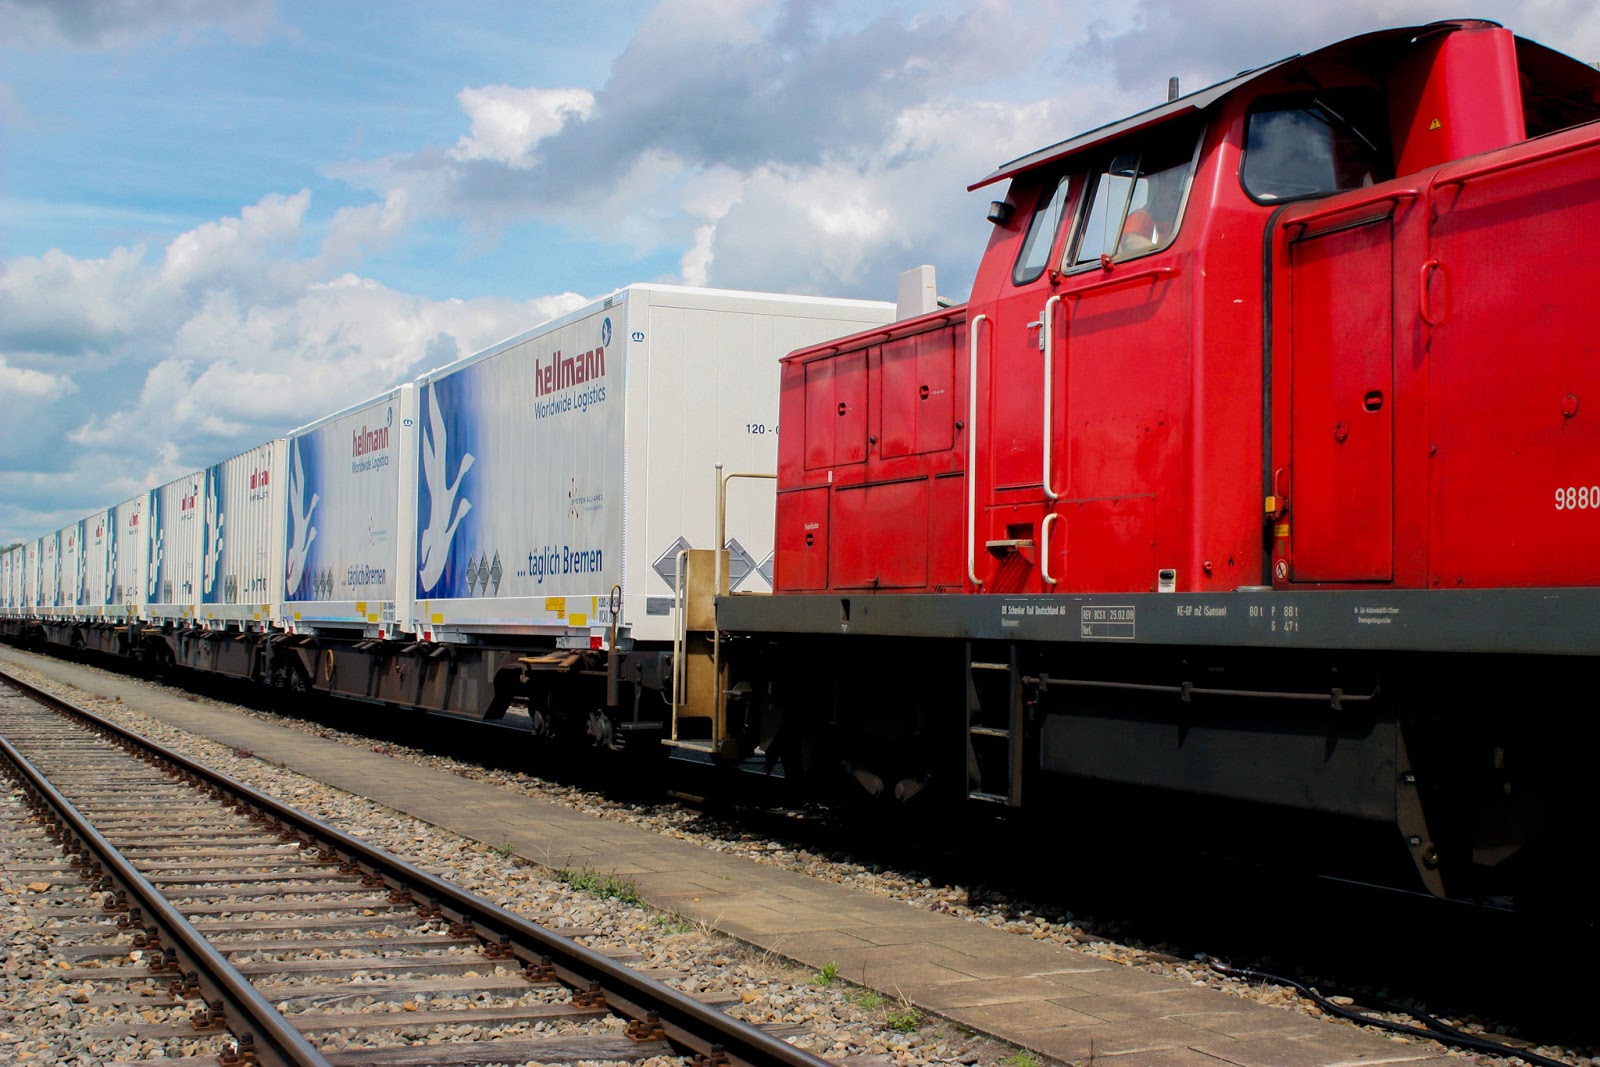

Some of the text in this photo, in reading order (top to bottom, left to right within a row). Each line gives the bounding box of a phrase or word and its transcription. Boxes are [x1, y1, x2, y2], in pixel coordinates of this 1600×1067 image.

[535, 346, 606, 398] hellmann
[534, 383, 606, 420] Worldwide Logistics
[746, 423, 765, 435] 120
[352, 425, 389, 458] hellmann
[1555, 485, 1600, 511] 9880
[528, 544, 560, 584] täglich
[563, 545, 602, 575] Bremen
[366, 564, 386, 585] Bremen
[1008, 605, 1025, 615] Schenker
[1026, 605, 1034, 615] Rail
[1035, 606, 1059, 616] Deutschland
[1059, 606, 1066, 616] AG
[1109, 610, 1134, 621] 25.02.08
[1176, 605, 1193, 617] KE-GP
[1249, 606, 1259, 617] 80
[1271, 606, 1276, 617] P
[1283, 606, 1294, 617] 88
[1283, 621, 1293, 632] 47
